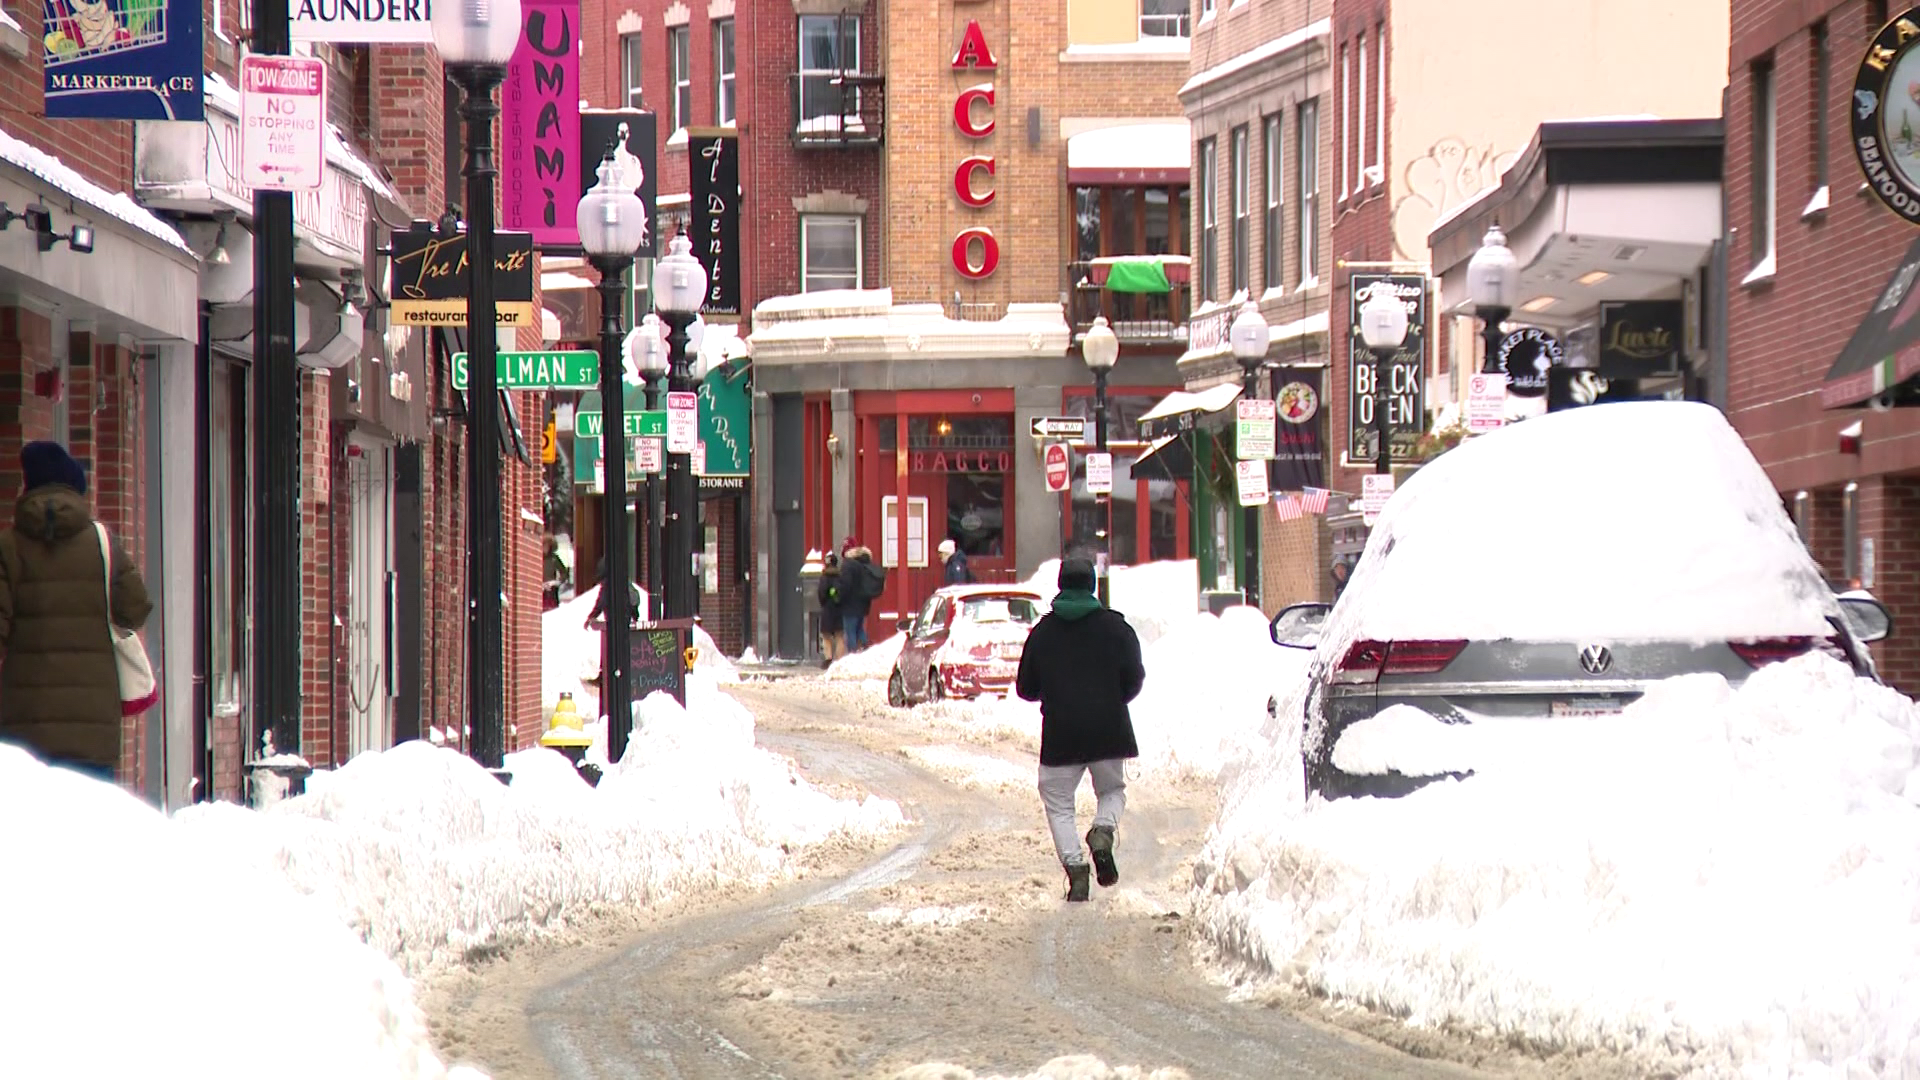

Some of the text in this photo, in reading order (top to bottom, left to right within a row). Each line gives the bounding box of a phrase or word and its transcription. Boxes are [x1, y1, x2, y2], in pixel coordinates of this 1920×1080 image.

[249, 66, 317, 90] TOW ZONE
[52, 74, 194, 98] MARKETPLACE
[267, 97, 296, 114] NO
[249, 117, 315, 130] STOPPING
[269, 132, 293, 142] ANY
[268, 143, 295, 154] TIME
[512, 64, 522, 228] CRUDO SUSHI BAR
[1857, 135, 1920, 217] SEAFOOD
[404, 311, 468, 323] restauran
[457, 357, 593, 387] SLMAN ST
[676, 411, 686, 419] NO
[1359, 394, 1414, 424] OEN
[651, 423, 662, 433] ST
[1064, 421, 1080, 431] WAY
[914, 451, 1008, 473] BACCO
[699, 478, 744, 488] ISTORANTE
